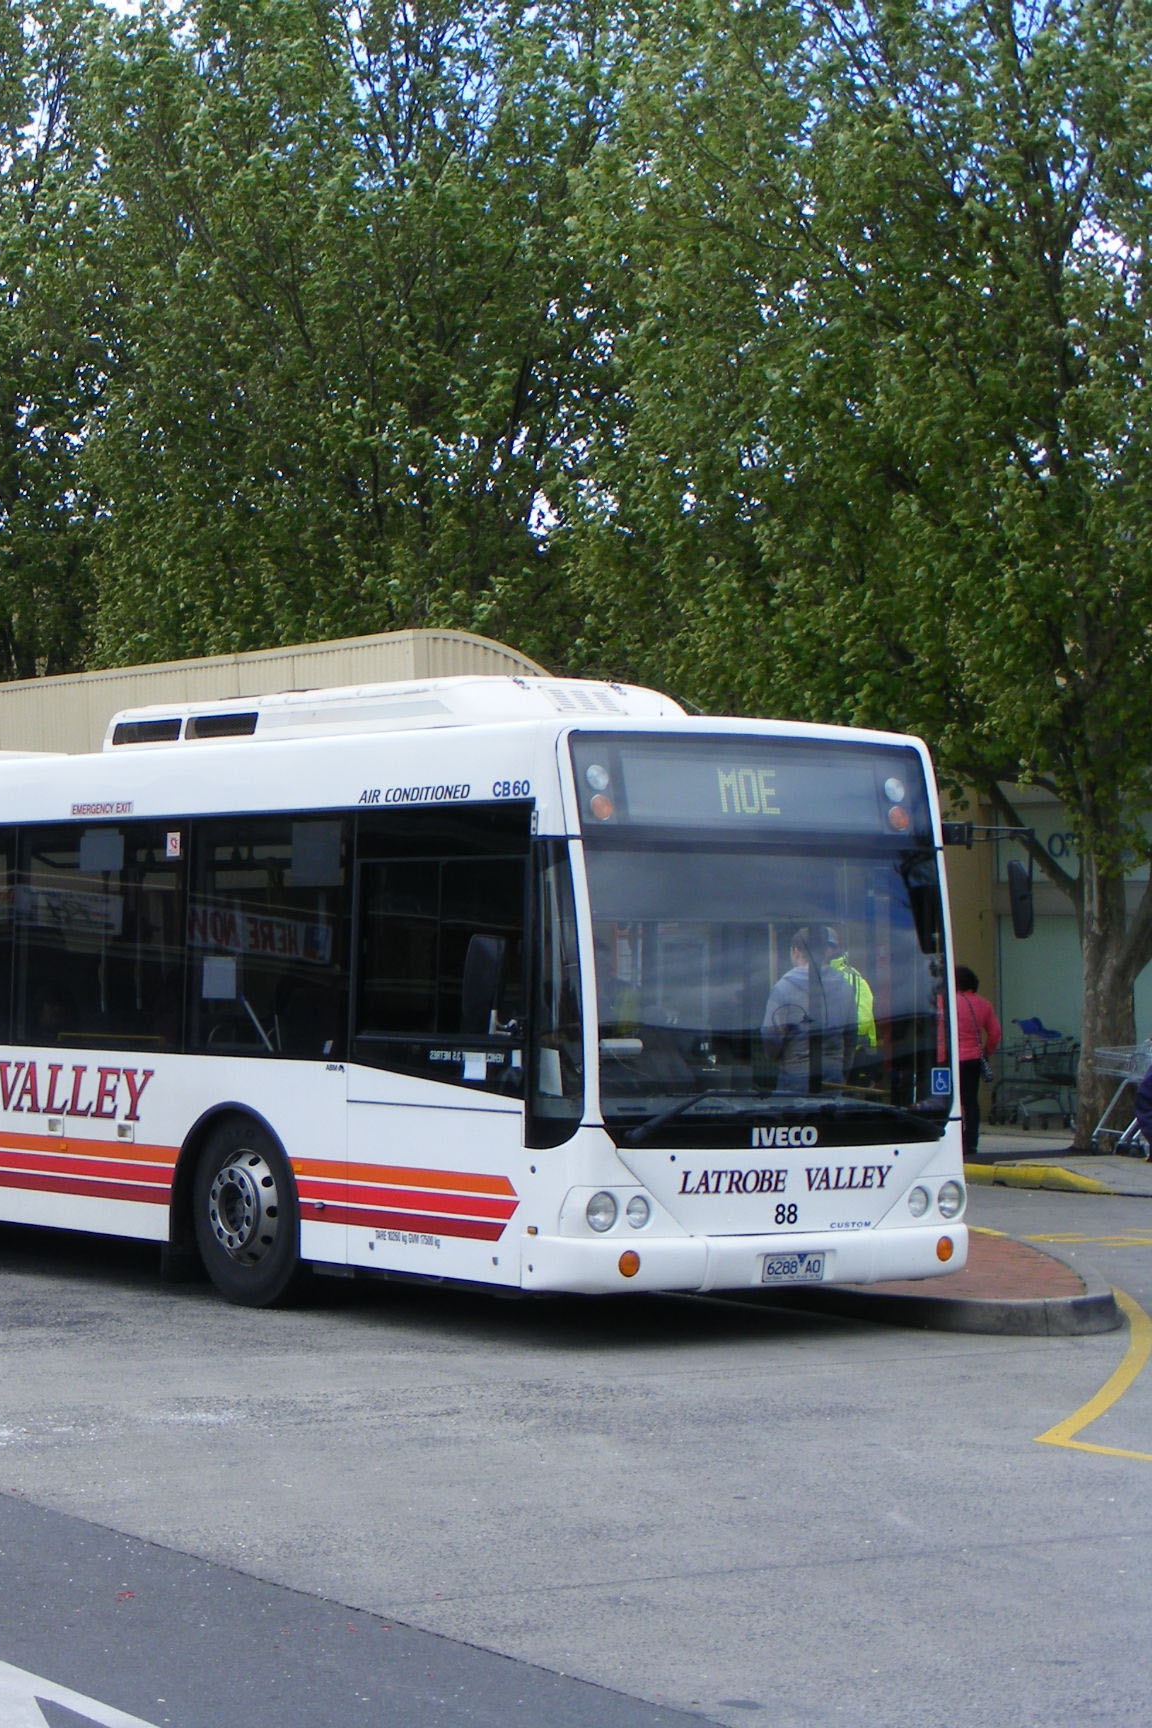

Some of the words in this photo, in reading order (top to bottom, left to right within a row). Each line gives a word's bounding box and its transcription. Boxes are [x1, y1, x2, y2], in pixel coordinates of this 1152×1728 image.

[358, 788, 381, 804] AIR
[385, 784, 471, 803] CONDITIONED
[717, 767, 781, 815] MOE
[72, 803, 114, 815] EMERGENCY
[116, 802, 132, 814] EXIT
[752, 1126, 818, 1147] IVECO
[678, 1169, 788, 1195] LATROBE
[805, 1164, 893, 1192] VALLEY
[774, 1203, 798, 1225] 88
[829, 1220, 872, 1229] CUSTOM
[767, 1260, 798, 1275] 6288
